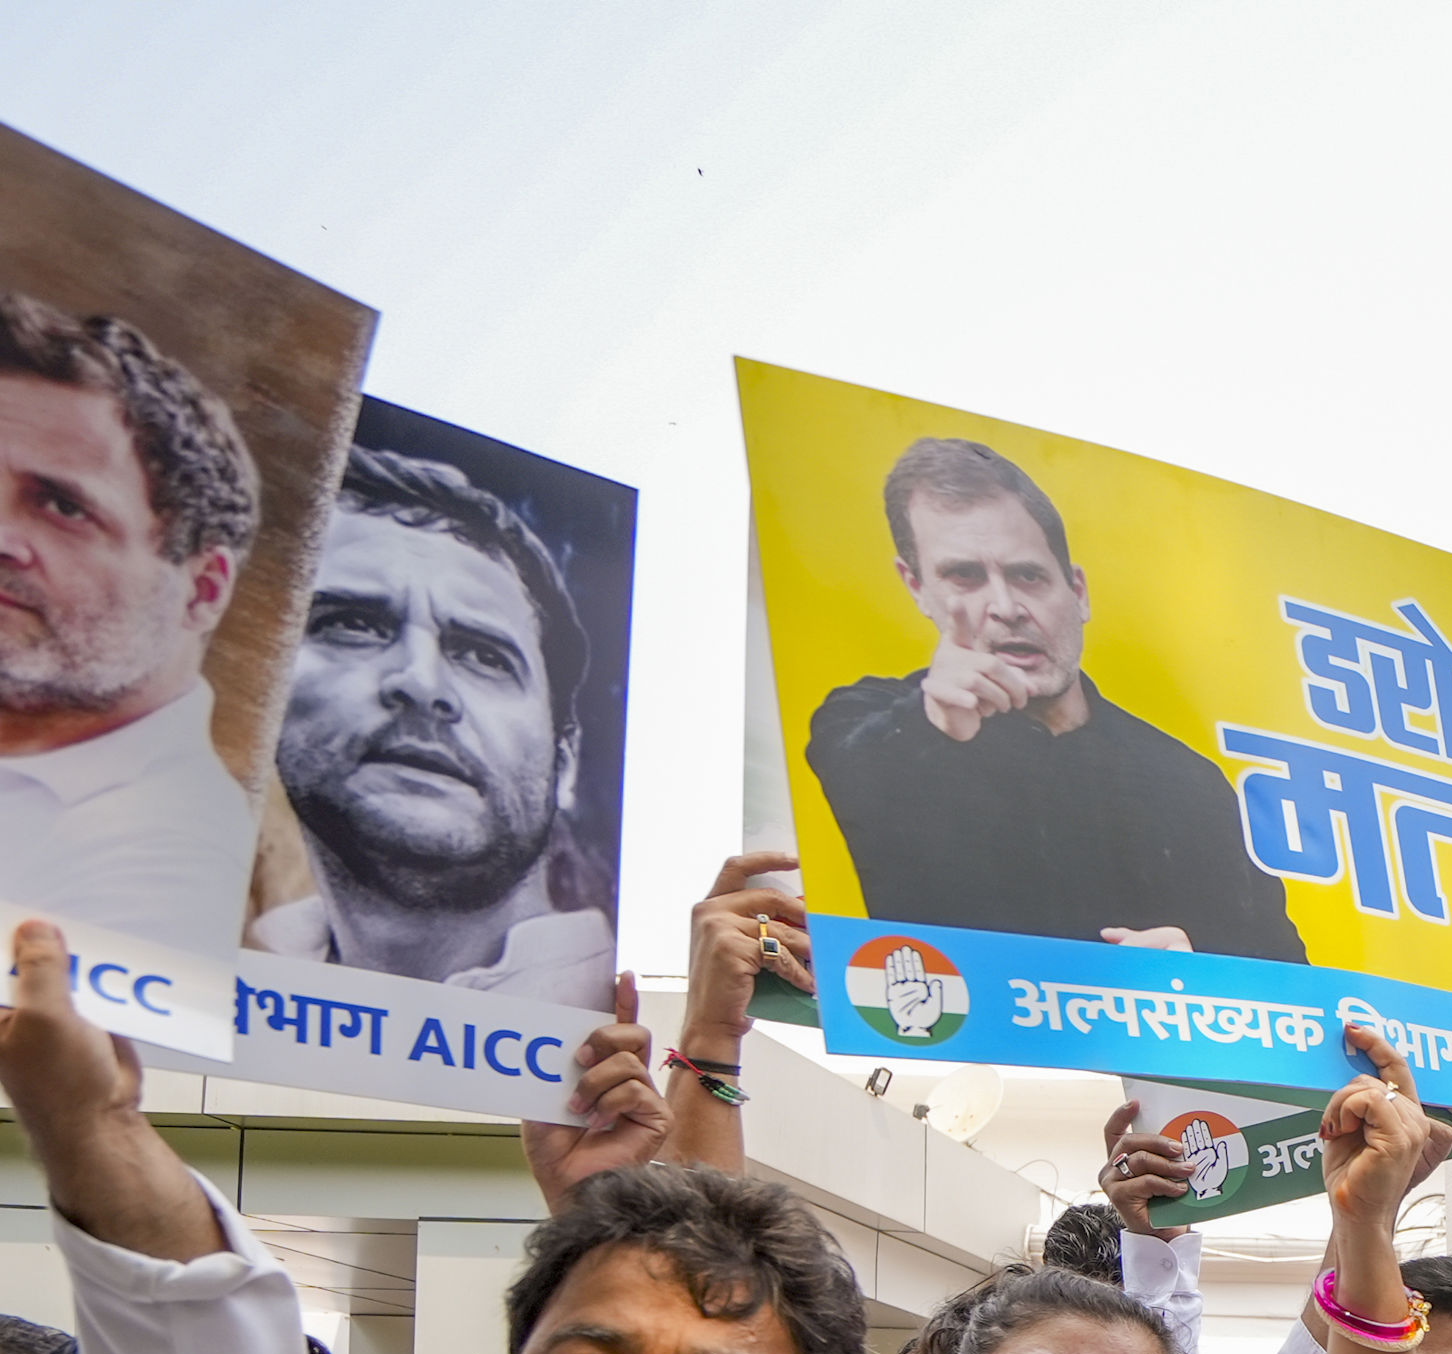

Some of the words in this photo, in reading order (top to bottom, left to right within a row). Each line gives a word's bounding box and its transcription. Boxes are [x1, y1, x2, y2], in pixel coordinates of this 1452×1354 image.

[9, 954, 173, 1016] ICC
[1008, 978, 1325, 1052] अल्पसंख्यक
[235, 976, 389, 1055] भाग
[408, 1017, 563, 1083] AICC
